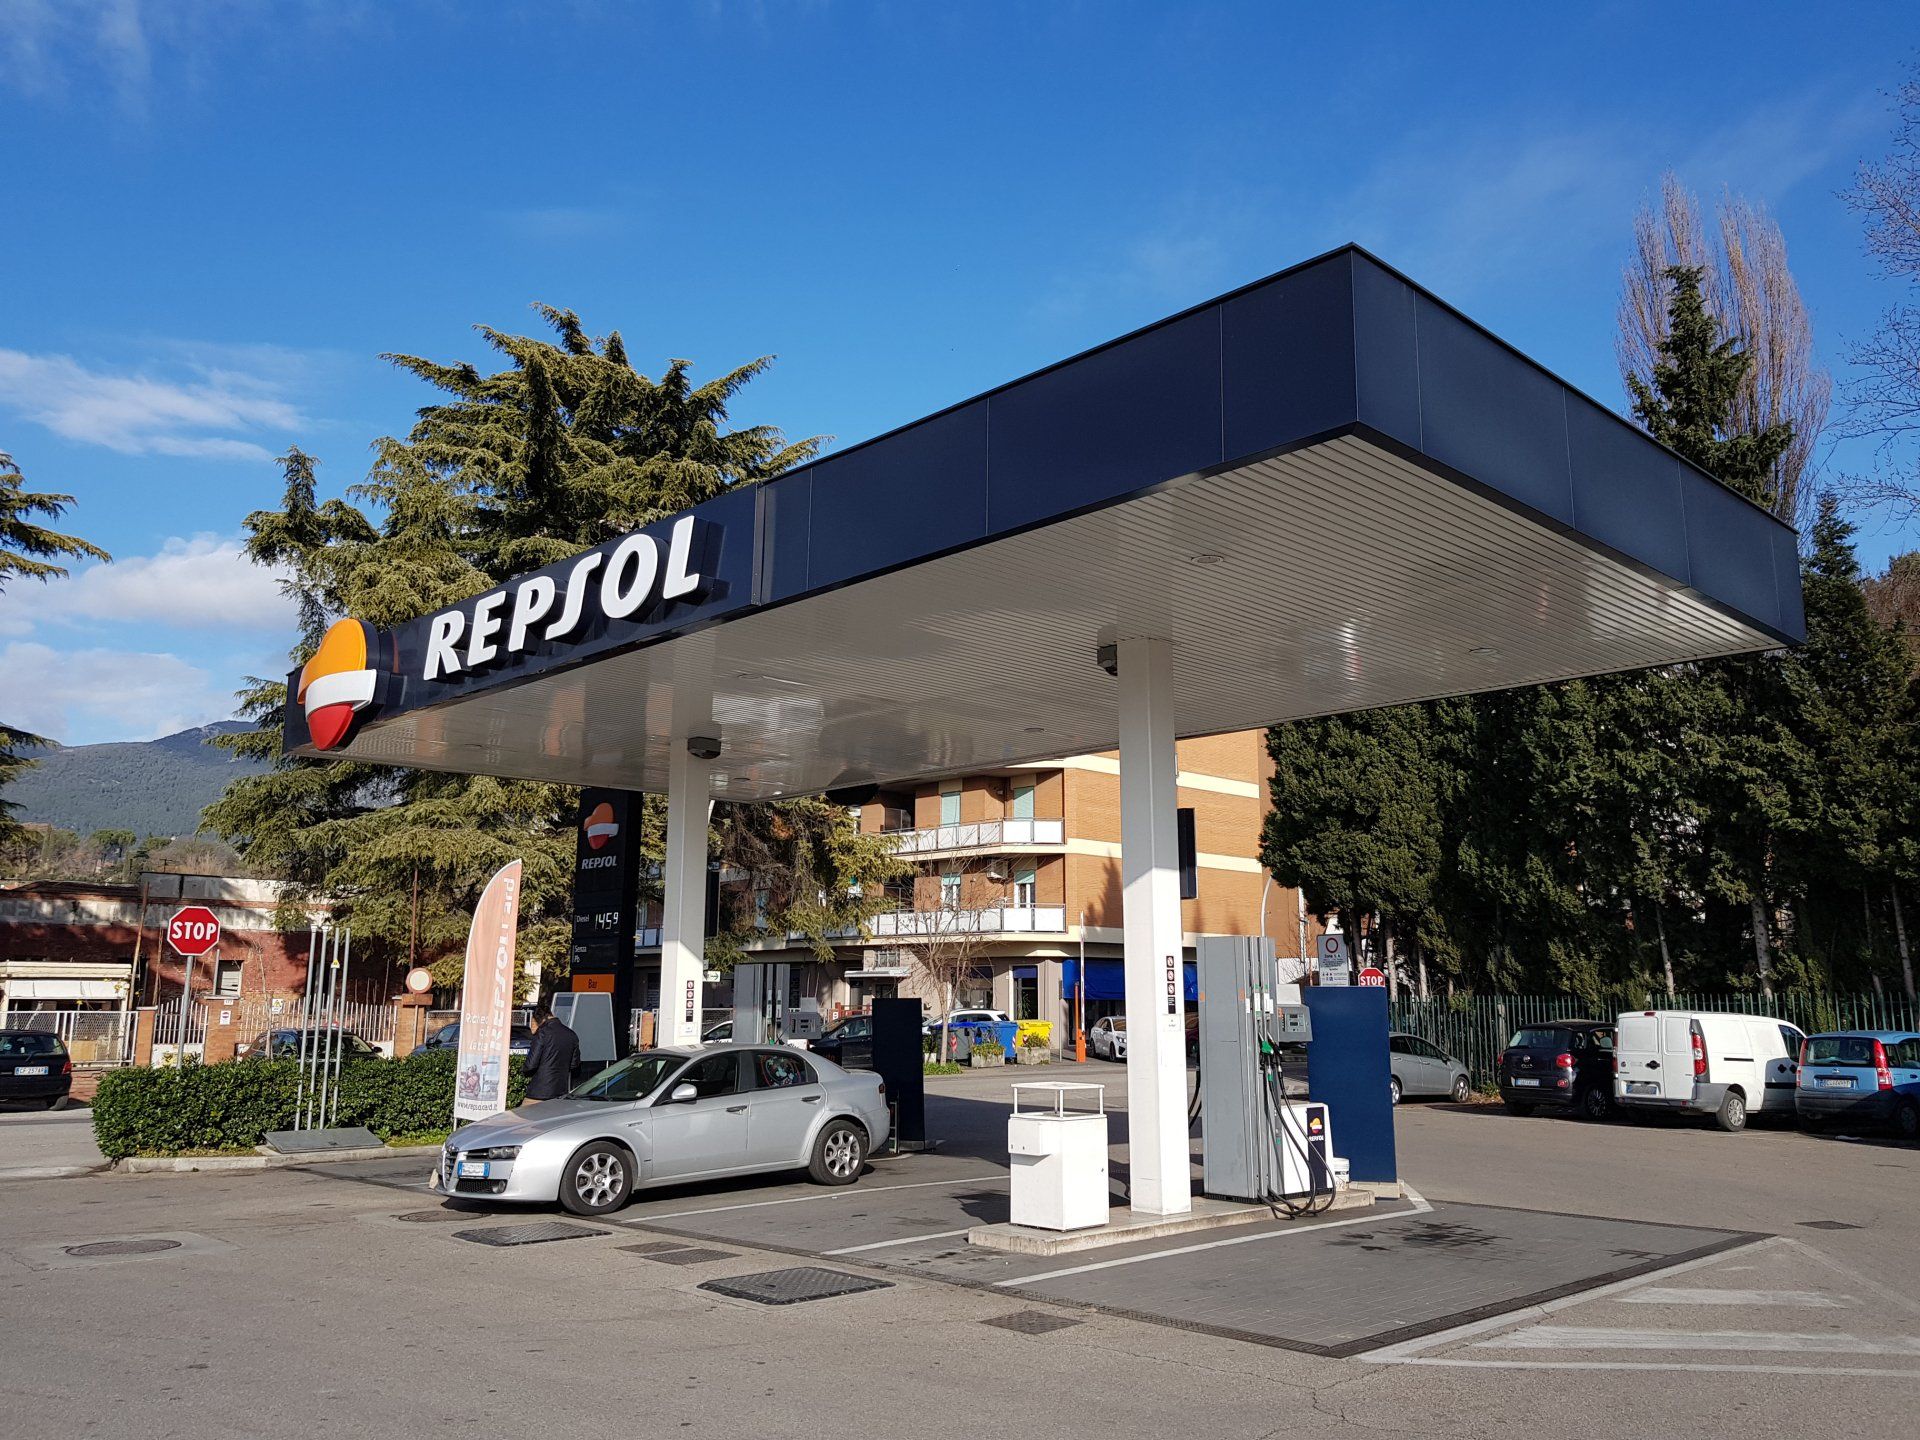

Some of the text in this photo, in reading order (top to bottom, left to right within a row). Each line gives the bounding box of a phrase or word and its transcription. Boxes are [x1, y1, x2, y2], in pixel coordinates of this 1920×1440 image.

[423, 515, 700, 681] REPSOL
[581, 855, 618, 870] REPSOL
[576, 914, 590, 923] Diesel
[171, 921, 217, 940] STOP
[574, 945, 587, 953] Senza
[588, 979, 598, 989] Bar
[1360, 975, 1384, 986] STOP
